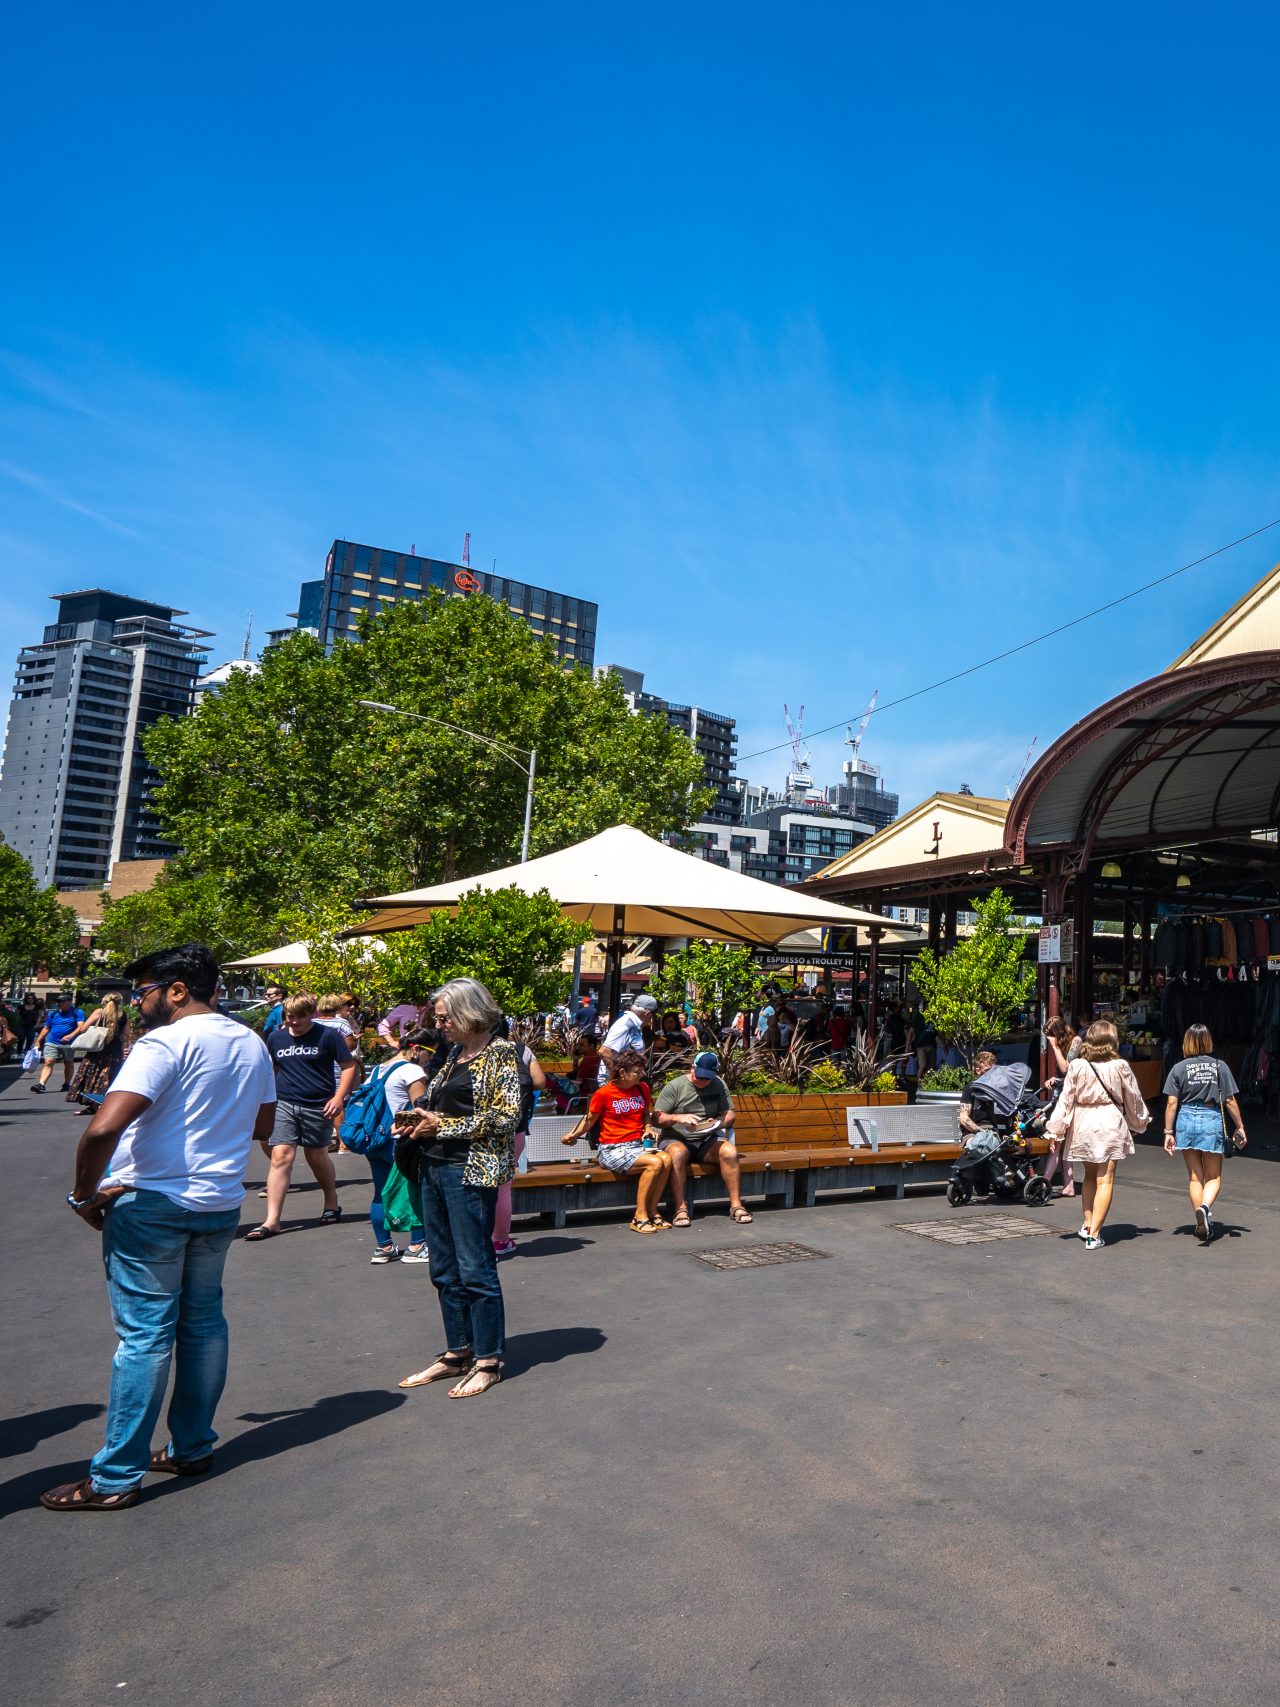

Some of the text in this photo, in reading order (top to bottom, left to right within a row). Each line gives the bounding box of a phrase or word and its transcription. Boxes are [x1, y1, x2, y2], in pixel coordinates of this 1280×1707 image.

[752, 955, 763, 963] ET
[766, 956, 805, 964] ESPRESSO
[811, 957, 843, 966] TROLLEY
[276, 1044, 319, 1058] adidas
